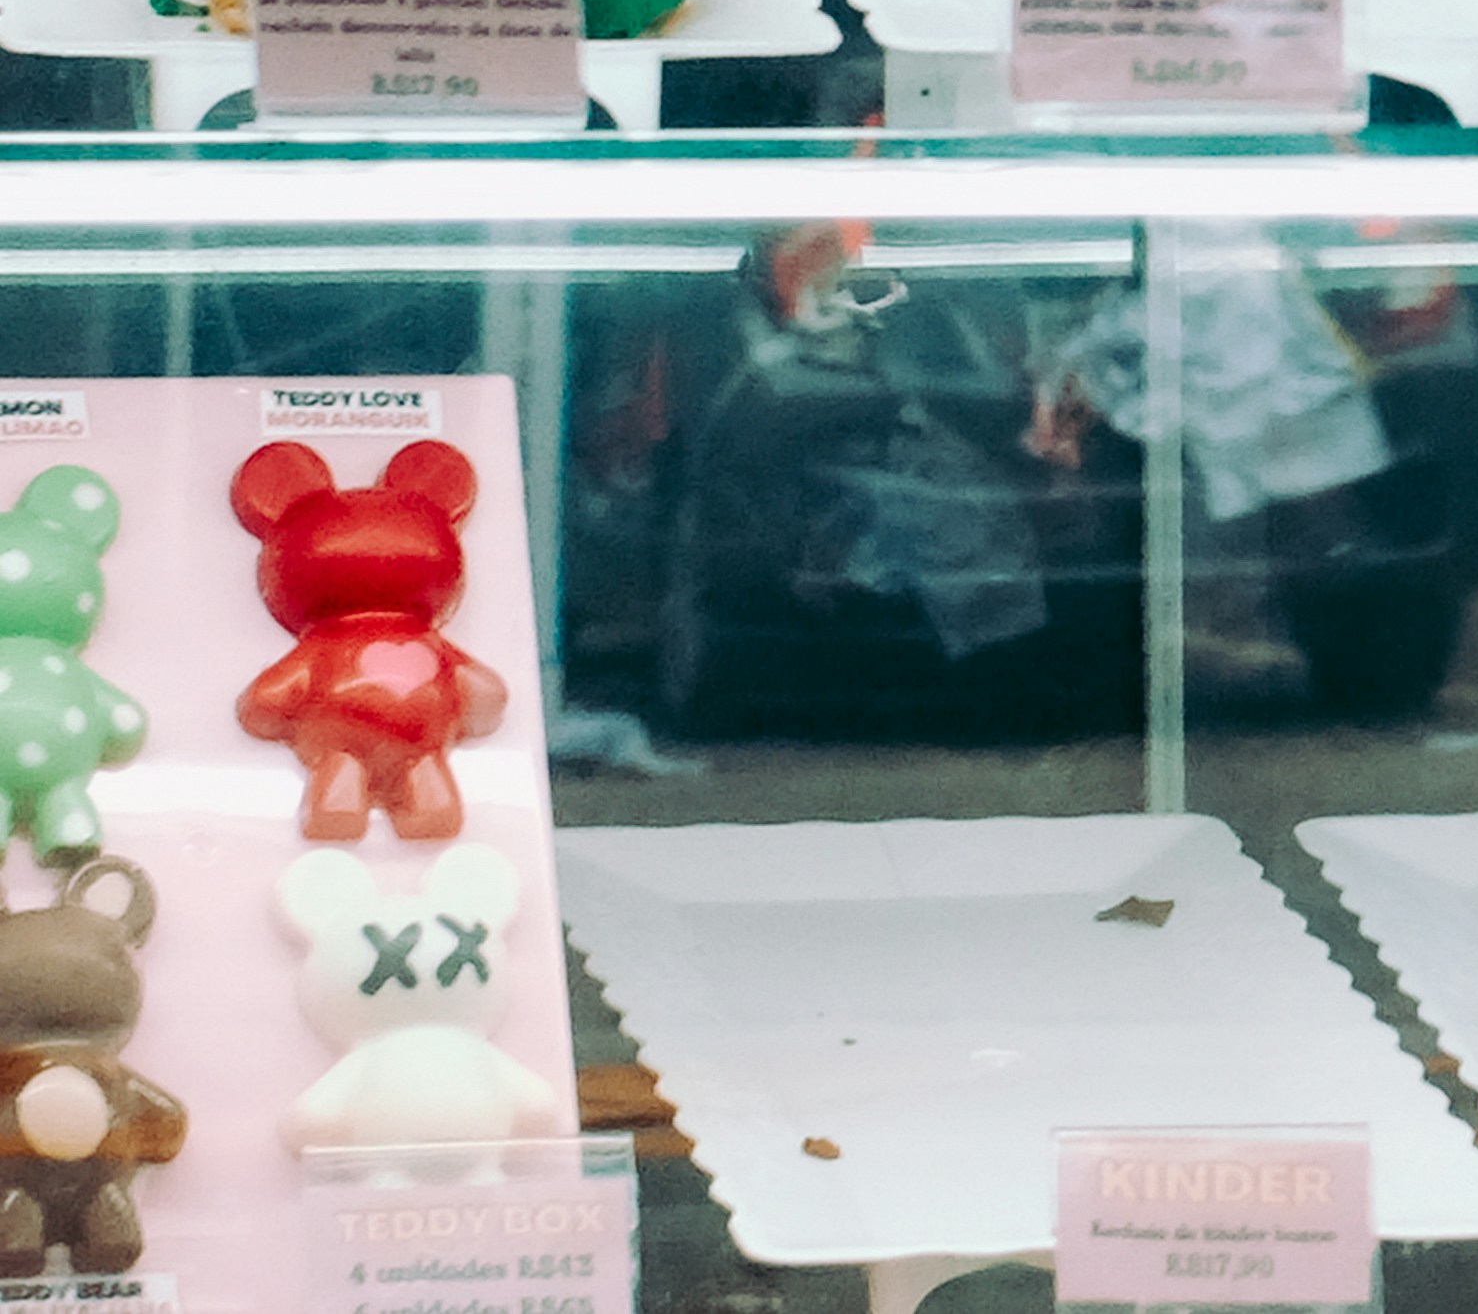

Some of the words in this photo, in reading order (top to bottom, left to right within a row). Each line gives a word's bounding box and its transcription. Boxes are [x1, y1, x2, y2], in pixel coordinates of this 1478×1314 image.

[272, 389, 353, 407] TEDDY
[360, 389, 423, 408] LOVE
[1097, 1158, 1334, 1205] KINDER
[337, 1207, 490, 1243] TEDDY
[503, 1203, 606, 1236] BOX
[350, 1261, 367, 1285] 4
[375, 1258, 508, 1284] unidades
[76, 1282, 142, 1301] BEAR
